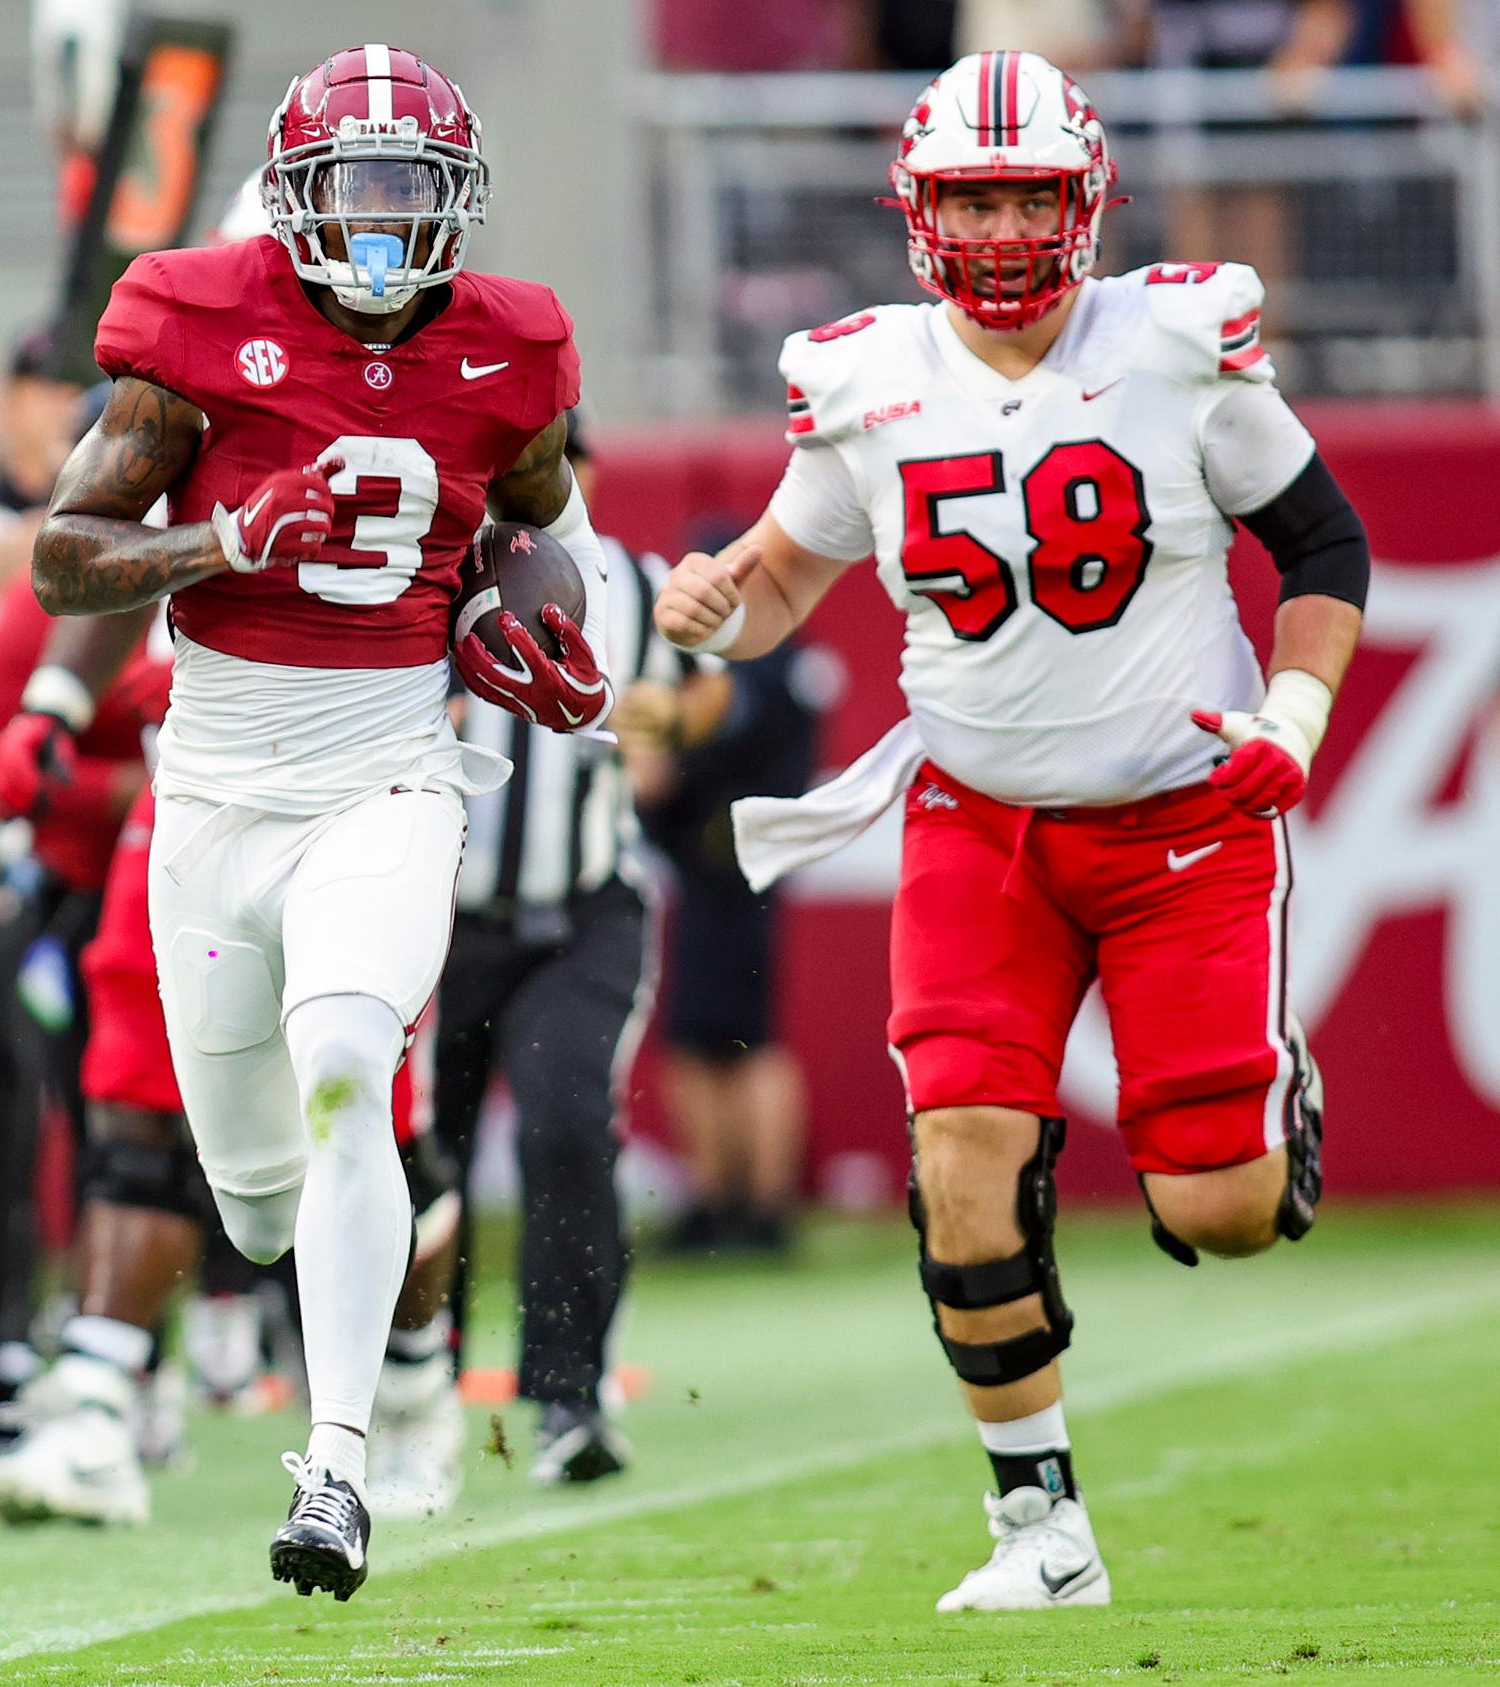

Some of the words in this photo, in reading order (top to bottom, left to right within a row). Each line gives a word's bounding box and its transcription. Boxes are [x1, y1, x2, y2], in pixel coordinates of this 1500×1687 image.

[103, 45, 222, 250] 3
[360, 123, 397, 135] BAMA
[239, 340, 286, 386] SEC
[297, 435, 439, 605] 3
[897, 437, 1154, 641] 58
